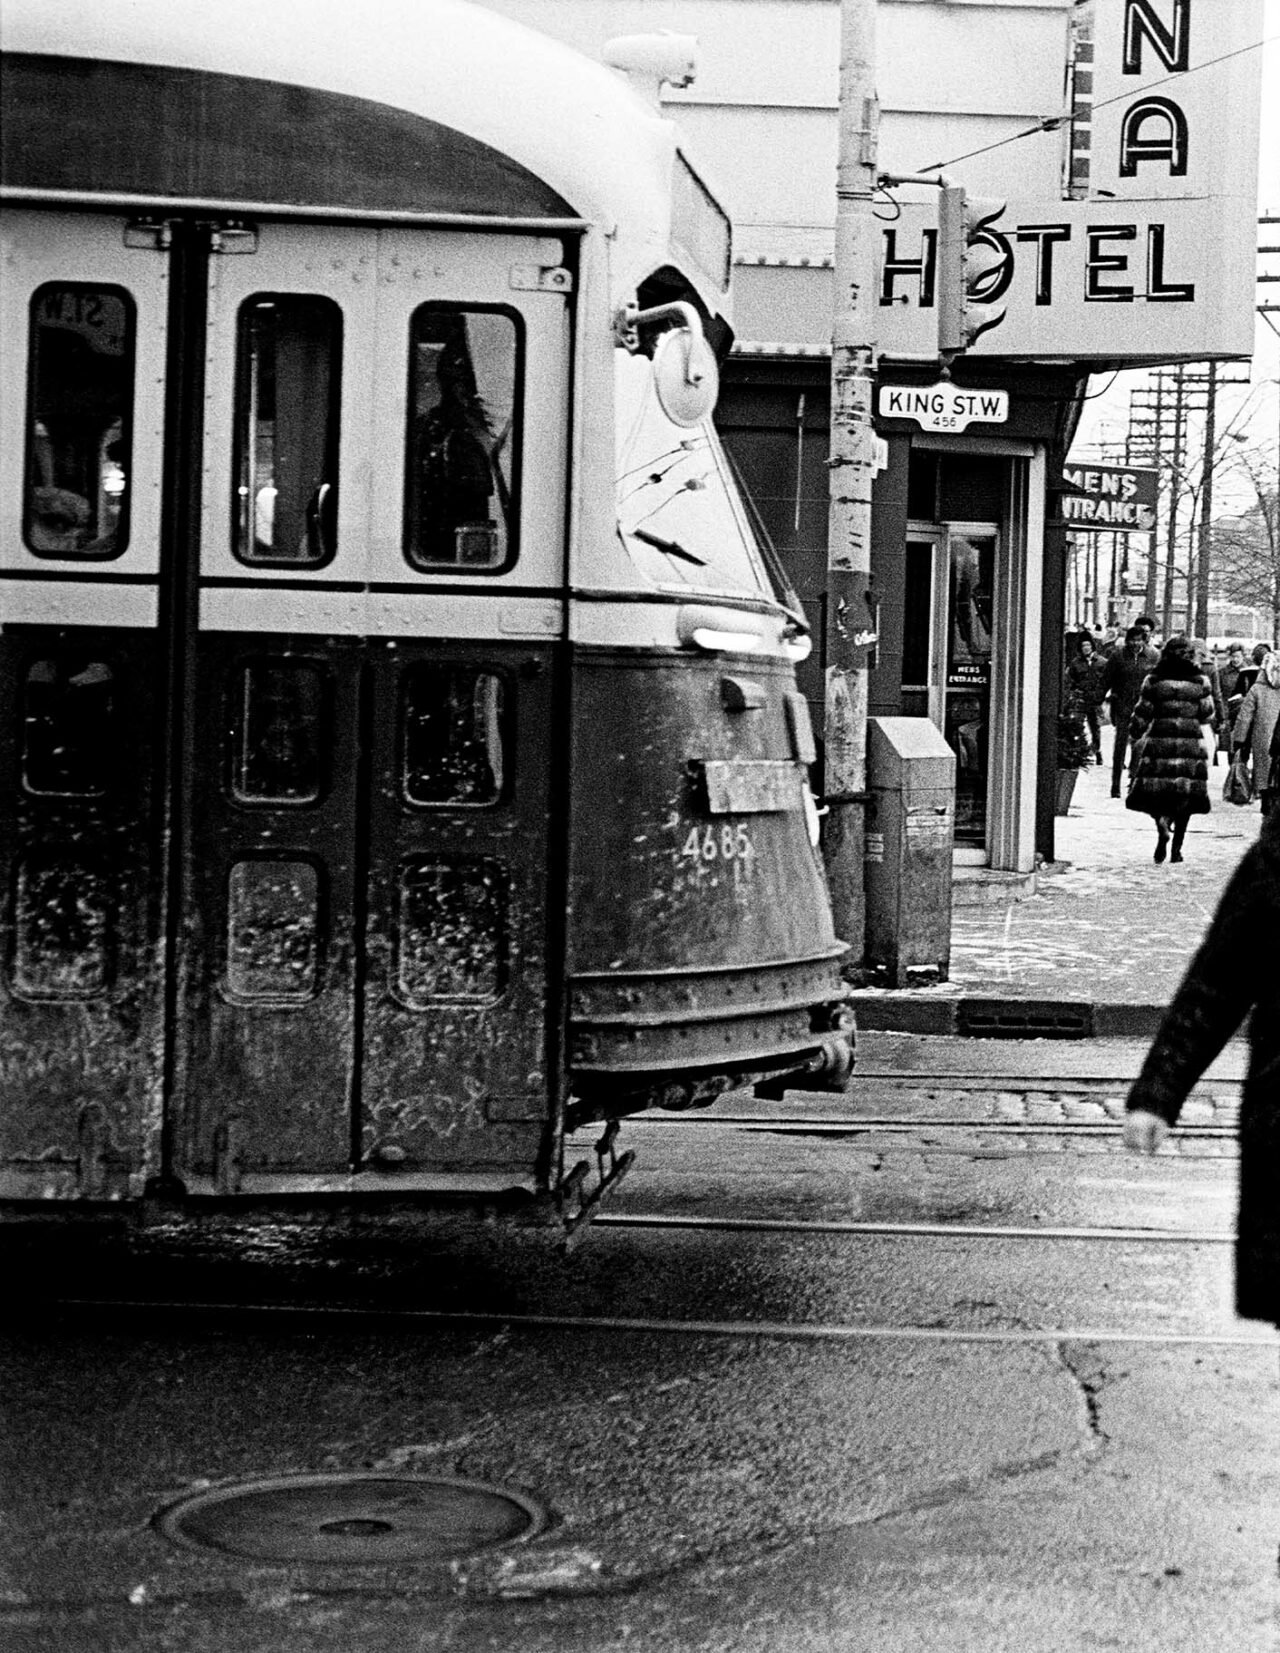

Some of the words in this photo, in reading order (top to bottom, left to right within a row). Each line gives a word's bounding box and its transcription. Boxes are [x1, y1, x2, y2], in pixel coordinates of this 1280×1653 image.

[879, 223, 1195, 308] HOTEL
[889, 391, 945, 415] KING
[932, 417, 957, 428] 456
[1061, 496, 1153, 526] NTRANCE
[682, 824, 751, 861] 4685
